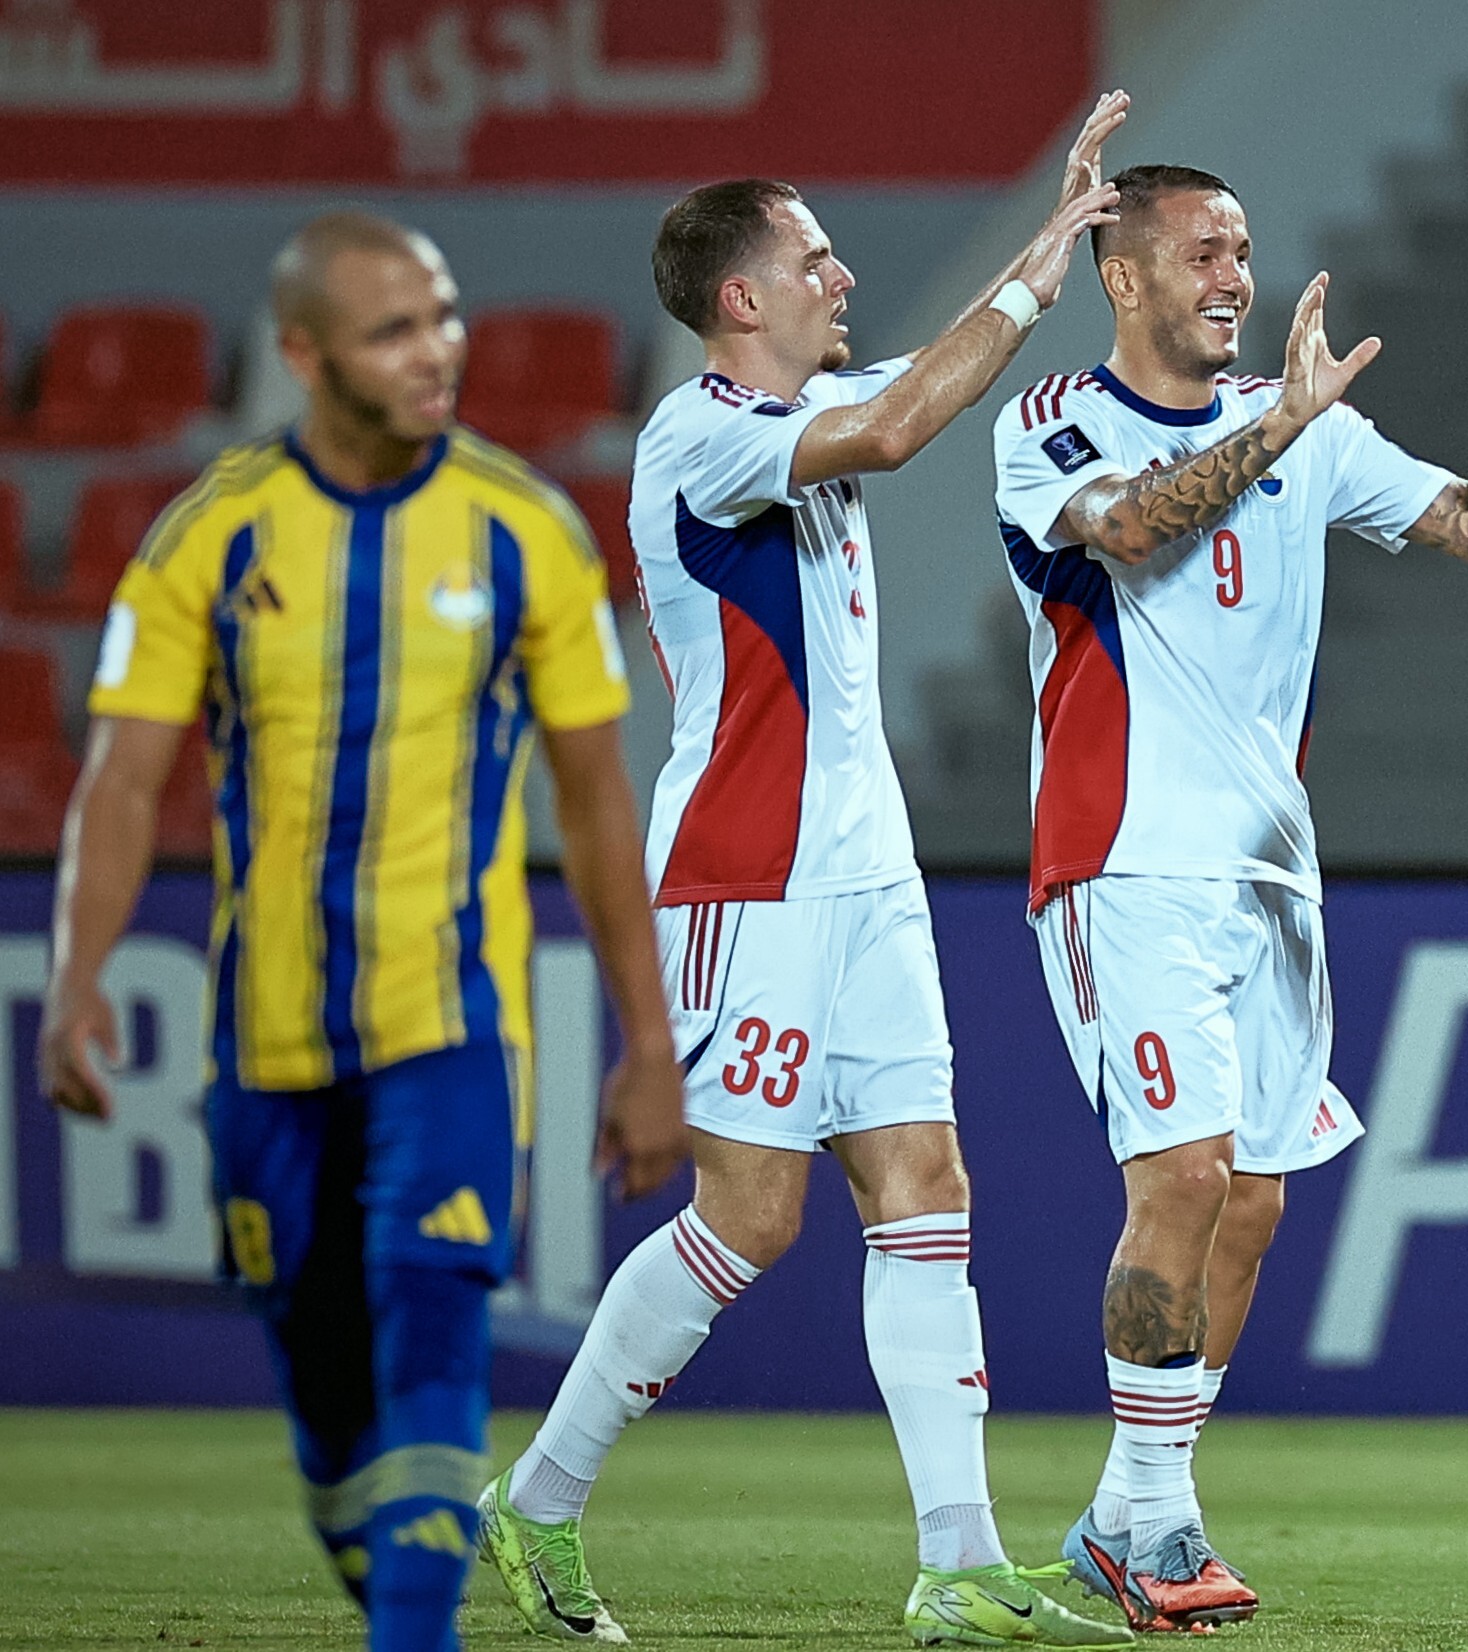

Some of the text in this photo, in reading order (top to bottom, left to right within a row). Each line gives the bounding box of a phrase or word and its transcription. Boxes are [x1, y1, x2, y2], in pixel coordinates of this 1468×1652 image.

[1213, 529, 1244, 608] 9
[722, 1016, 810, 1108] 33
[1133, 1030, 1176, 1110] 9
